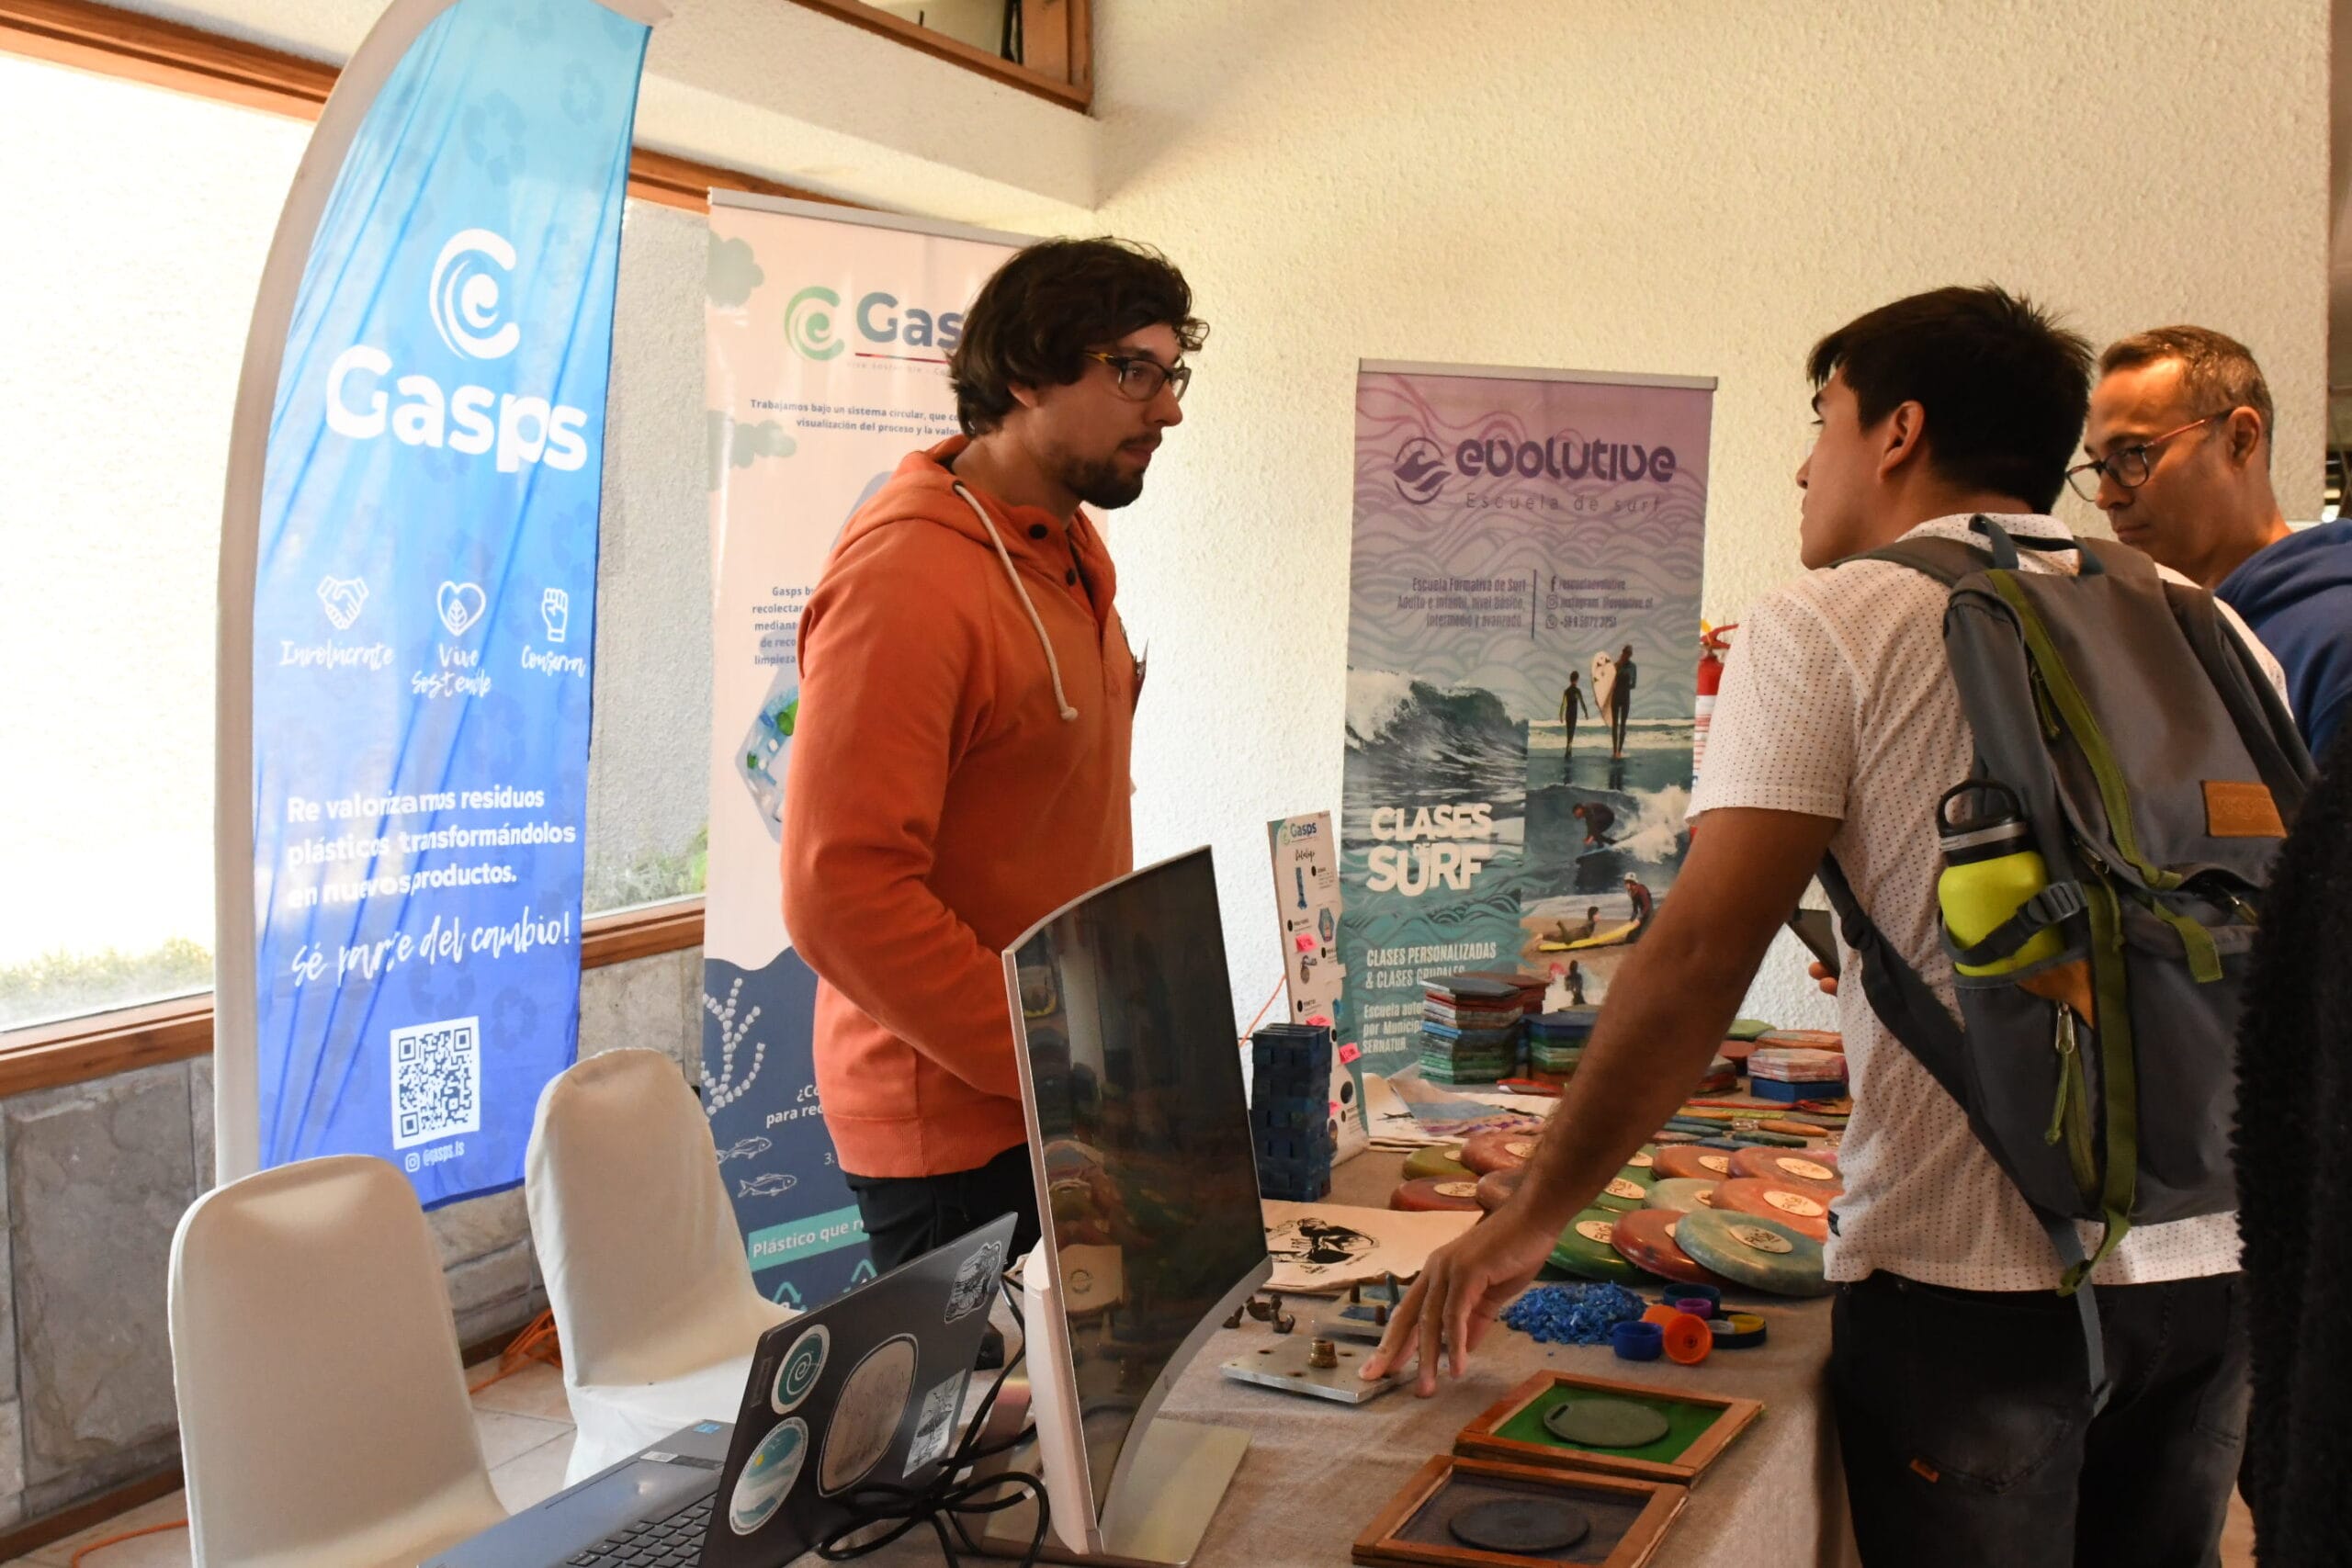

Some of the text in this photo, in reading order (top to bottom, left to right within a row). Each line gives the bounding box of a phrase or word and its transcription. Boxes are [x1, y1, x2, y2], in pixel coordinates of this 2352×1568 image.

[326, 344, 588, 472] Gasps
[751, 400, 808, 412] Trabajamos
[811, 403, 831, 415] bajo
[833, 406, 845, 414] un
[848, 406, 887, 417] sistema
[889, 409, 927, 422] circular,
[929, 413, 946, 423] que
[796, 418, 856, 431] visualización
[860, 421, 876, 431] del
[878, 424, 914, 435] proceso
[916, 427, 922, 436] y
[924, 425, 933, 434] la
[1455, 437, 1677, 483] evolutive
[1465, 492, 1661, 513] Escuela de surf
[772, 586, 802, 599] Gasps
[1412, 578, 1526, 592] Escuela Formativa de Surf
[752, 604, 803, 614] recolectar
[754, 620, 797, 632] mediant
[760, 637, 773, 649] de
[438, 642, 481, 669] Vive
[754, 653, 797, 667] limpieza
[287, 784, 545, 823] Re valorizamos residuos
[1290, 822, 1317, 838] Gasps
[1370, 803, 1493, 841] CLASES
[287, 821, 576, 869] plásticos transformándolos
[1365, 842, 1490, 897] SURF
[288, 863, 517, 908] en nuevos productos.
[419, 915, 467, 964] del
[470, 905, 571, 958] cambio!
[1366, 942, 1497, 967] CLASES PERSONALIZADAS
[1365, 971, 1374, 989] &
[1377, 969, 1413, 988] CLASES
[1363, 1002, 1399, 1019] Escuela
[1363, 1022, 1380, 1038] por
[1363, 1037, 1408, 1054] SERNATUR.
[765, 1109, 798, 1129] para
[824, 1152, 835, 1165] 3.
[753, 1232, 816, 1258] Plástico
[820, 1224, 850, 1244] que
